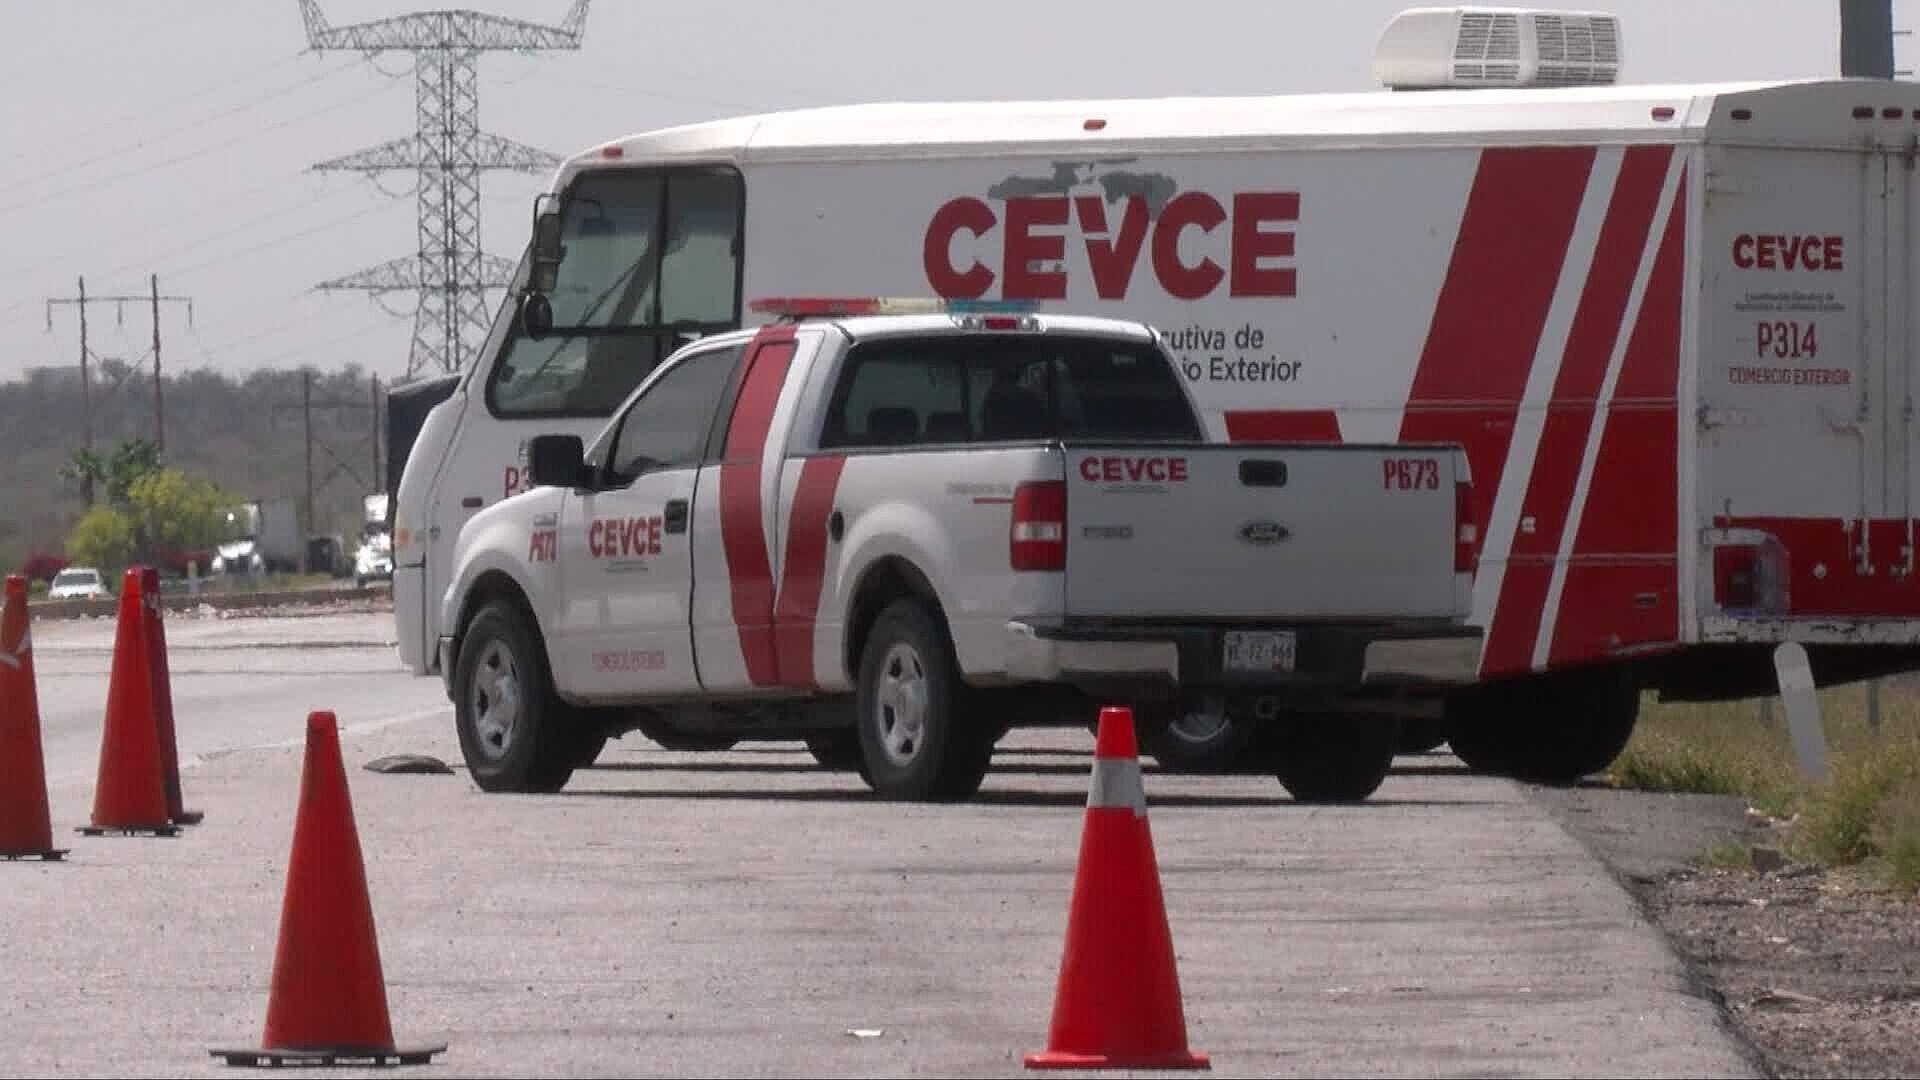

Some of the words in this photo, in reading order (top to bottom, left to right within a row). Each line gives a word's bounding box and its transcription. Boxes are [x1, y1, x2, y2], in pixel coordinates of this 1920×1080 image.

[923, 191, 1301, 301] CEVCE
[1732, 233, 1844, 271] CEVCE
[1235, 324, 1265, 349] de
[1757, 321, 1817, 359] P314
[1209, 355, 1302, 382] Exterior
[1080, 456, 1188, 482] CEVCE
[1383, 459, 1440, 490] P673
[589, 516, 662, 557] CEVCE
